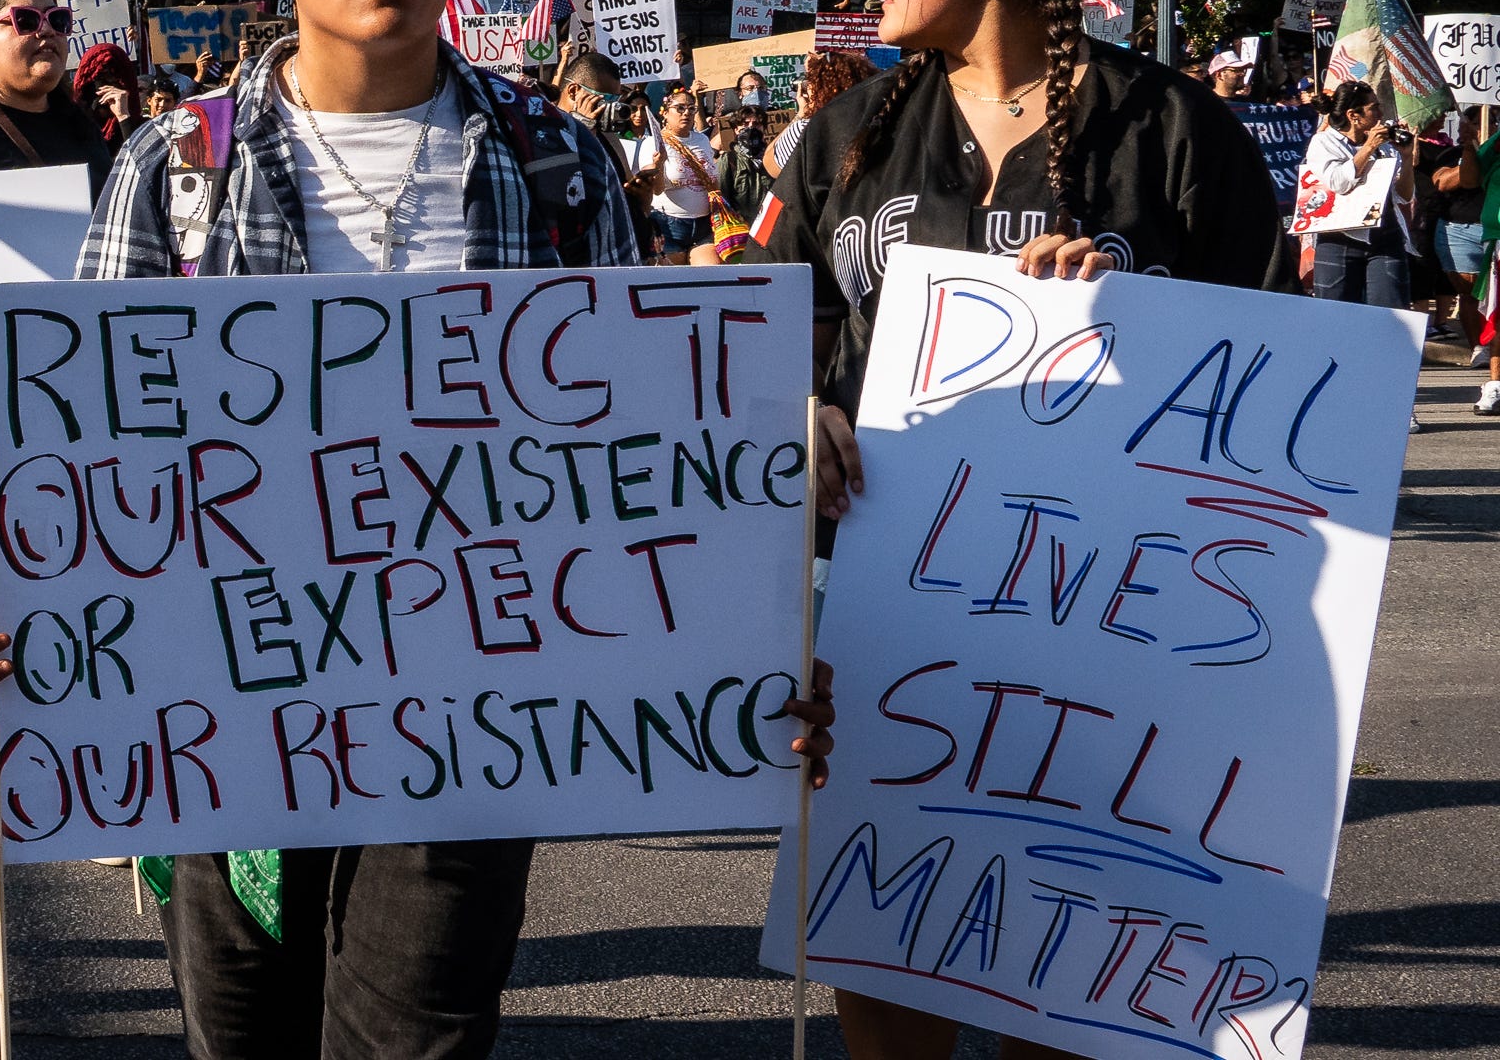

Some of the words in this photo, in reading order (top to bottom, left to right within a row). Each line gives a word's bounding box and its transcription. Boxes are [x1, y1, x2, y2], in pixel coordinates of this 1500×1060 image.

[461, 16, 485, 28] MADE
[488, 16, 501, 28] IN
[502, 16, 518, 27] THE
[601, 11, 660, 32] JESUS
[736, 6, 759, 18] ARE
[608, 34, 669, 58] CHRIST.
[1316, 31, 1335, 49] NO
[620, 58, 663, 79] ERIOD
[753, 54, 808, 68] LIBERTY
[770, 64, 796, 75] AND
[1242, 119, 1313, 145] TRUMP
[1275, 149, 1302, 162] FOR
[5, 276, 773, 448] RESPECT
[910, 273, 1116, 426] DO
[1125, 339, 1359, 495] ALL
[909, 457, 1276, 667] LIVES
[12, 594, 136, 706] OR
[211, 534, 698, 693] EXPECT
[0, 700, 223, 842] OUR
[870, 660, 1286, 875] STILL
[805, 821, 1311, 1060] MATTER?
